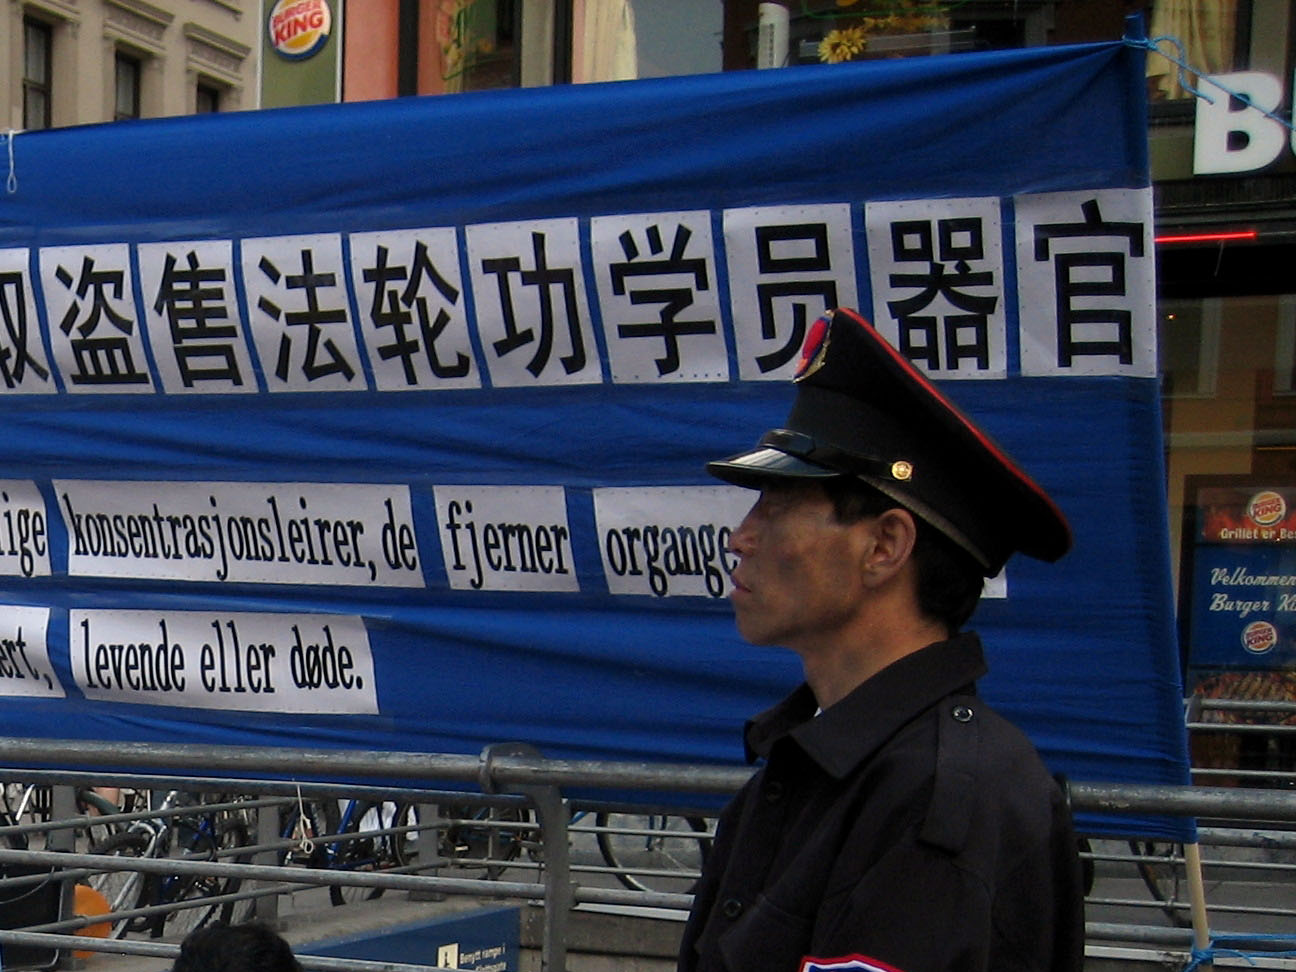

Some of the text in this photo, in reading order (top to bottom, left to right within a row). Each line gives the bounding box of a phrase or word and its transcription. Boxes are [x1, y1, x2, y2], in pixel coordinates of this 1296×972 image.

[274, 9, 324, 47] KING
[1193, 68, 1296, 175] B
[62, 493, 377, 582] konsentrasjonsleirer,
[381, 498, 417, 572] de
[445, 500, 569, 590] fjerner
[1210, 566, 1296, 586] Velkommen
[1209, 593, 1296, 618] Burger Ki
[80, 618, 186, 692] levende
[200, 619, 276, 693] eller
[290, 624, 364, 690] døde.
